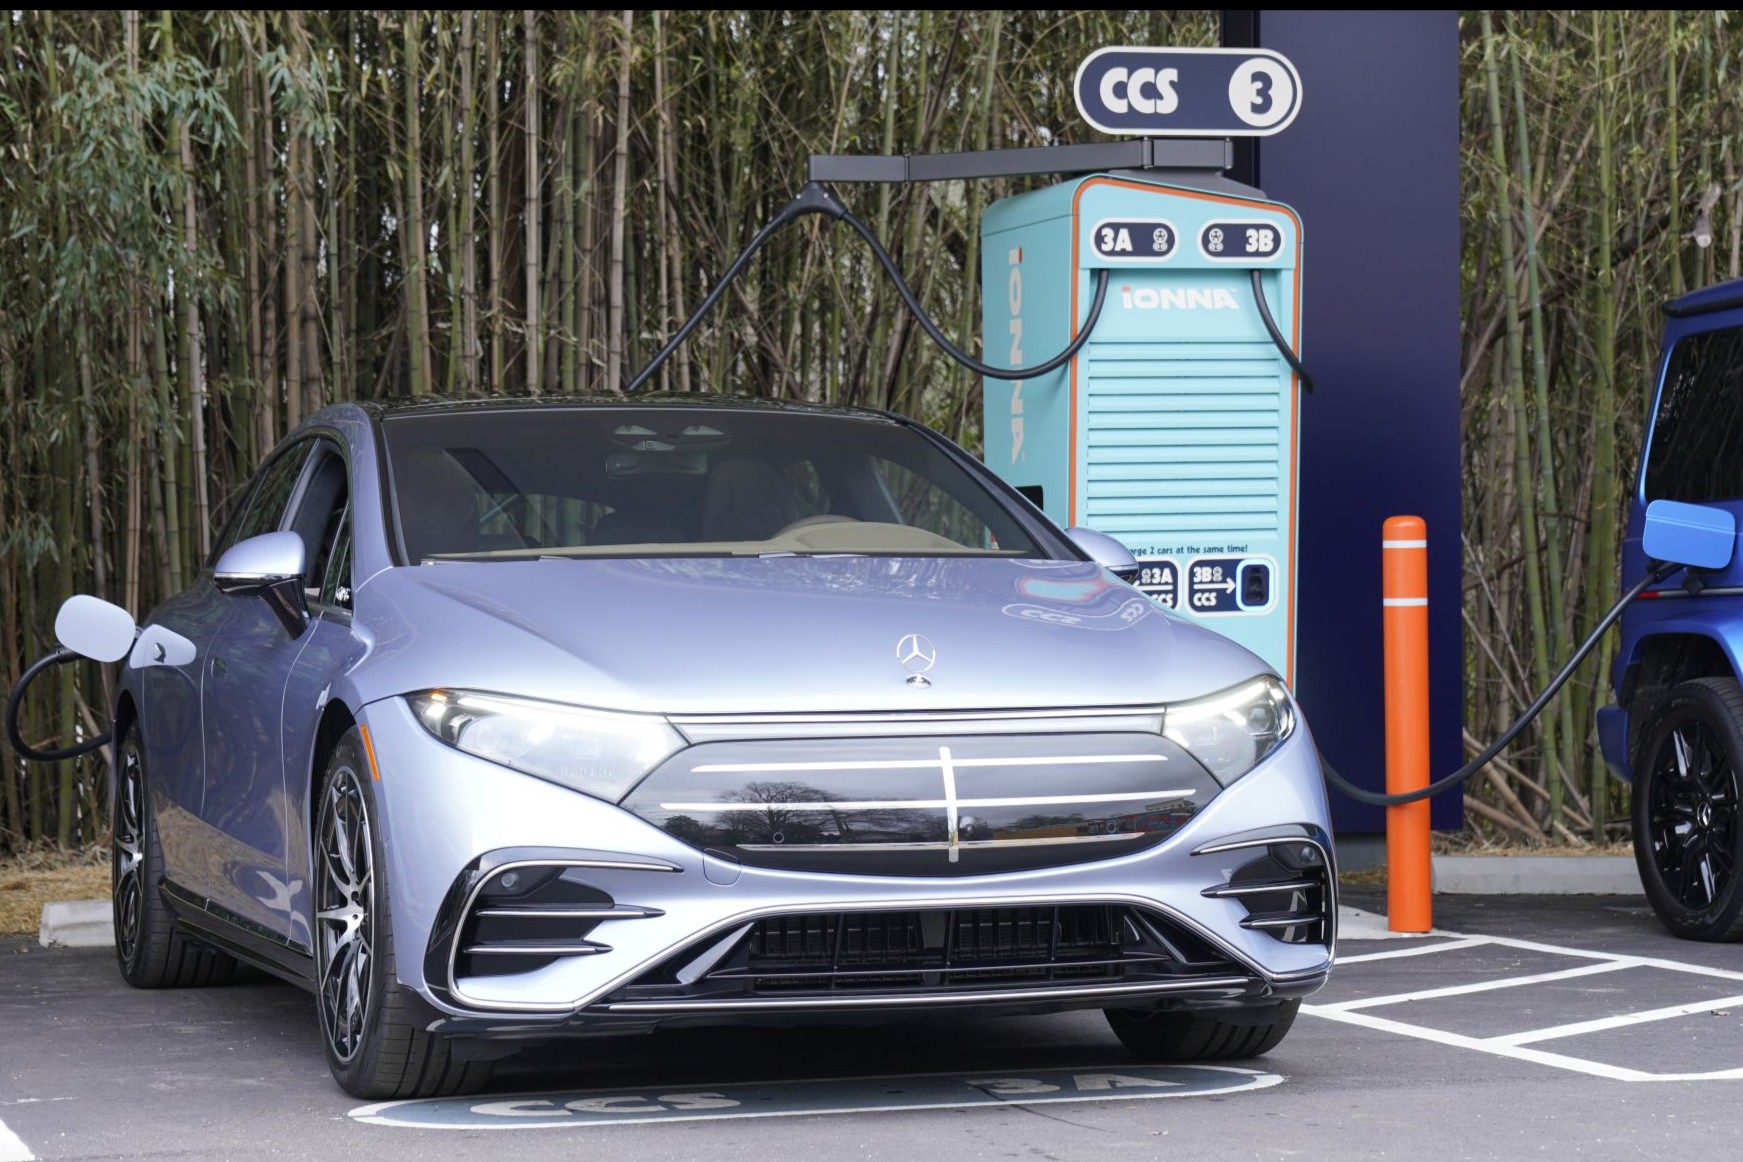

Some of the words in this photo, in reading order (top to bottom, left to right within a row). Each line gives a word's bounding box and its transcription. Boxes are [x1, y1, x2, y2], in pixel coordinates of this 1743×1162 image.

[1099, 66, 1179, 114] CCS
[1250, 70, 1274, 115] 3
[1101, 228, 1133, 252] 3A
[1245, 228, 1275, 253] 3B
[1150, 546, 1155, 555] 2
[1157, 547, 1173, 555] cars
[1176, 546, 1184, 554] at
[1187, 545, 1201, 554] the
[1203, 546, 1224, 554] same
[1227, 544, 1248, 553] time!
[1151, 568, 1173, 584] 3A
[1193, 566, 1213, 583] 3B
[1193, 592, 1217, 607] CCS
[470, 1092, 741, 1117] CCS
